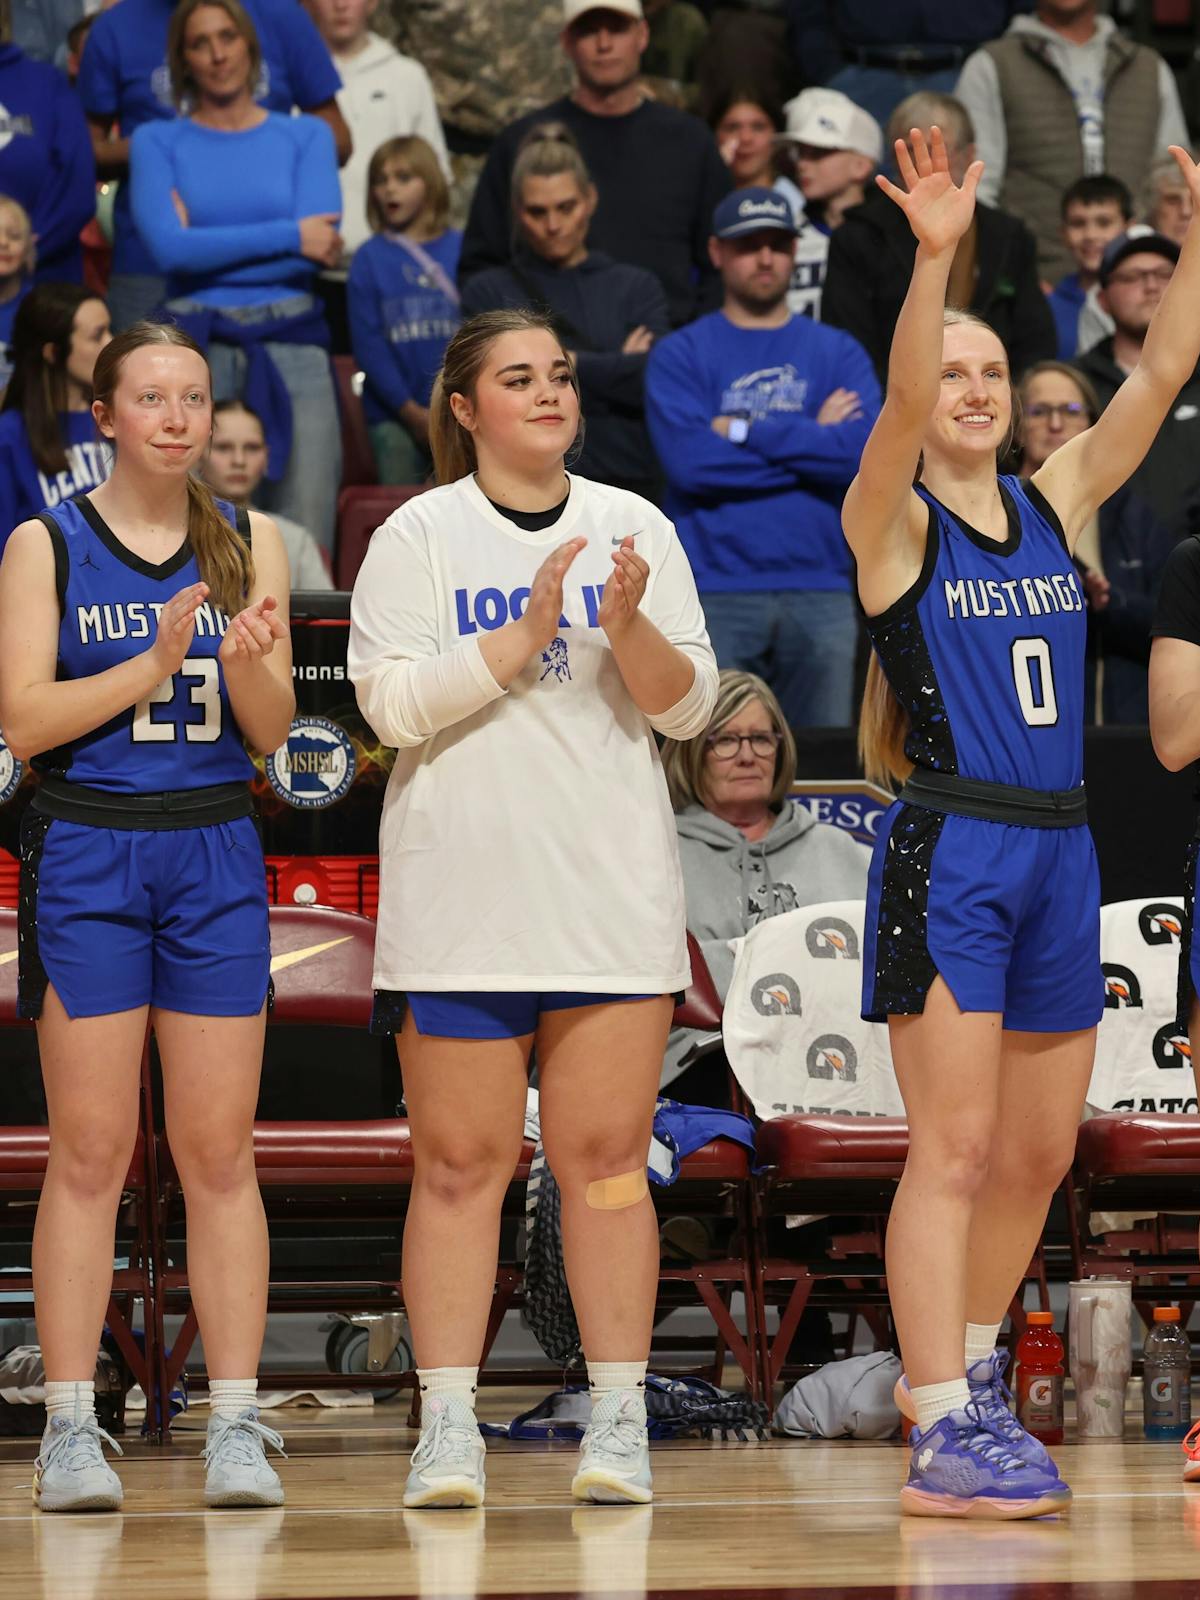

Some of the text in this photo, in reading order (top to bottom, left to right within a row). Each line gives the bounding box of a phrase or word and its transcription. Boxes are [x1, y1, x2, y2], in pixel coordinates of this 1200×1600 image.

[581, 584, 606, 629] I
[943, 573, 1083, 618] MUSTANGS
[131, 657, 223, 743] 23
[1010, 636, 1059, 727] 0
[284, 752, 338, 773] MSHSL
[1029, 1380, 1052, 1406] G
[1150, 1375, 1172, 1402] G
